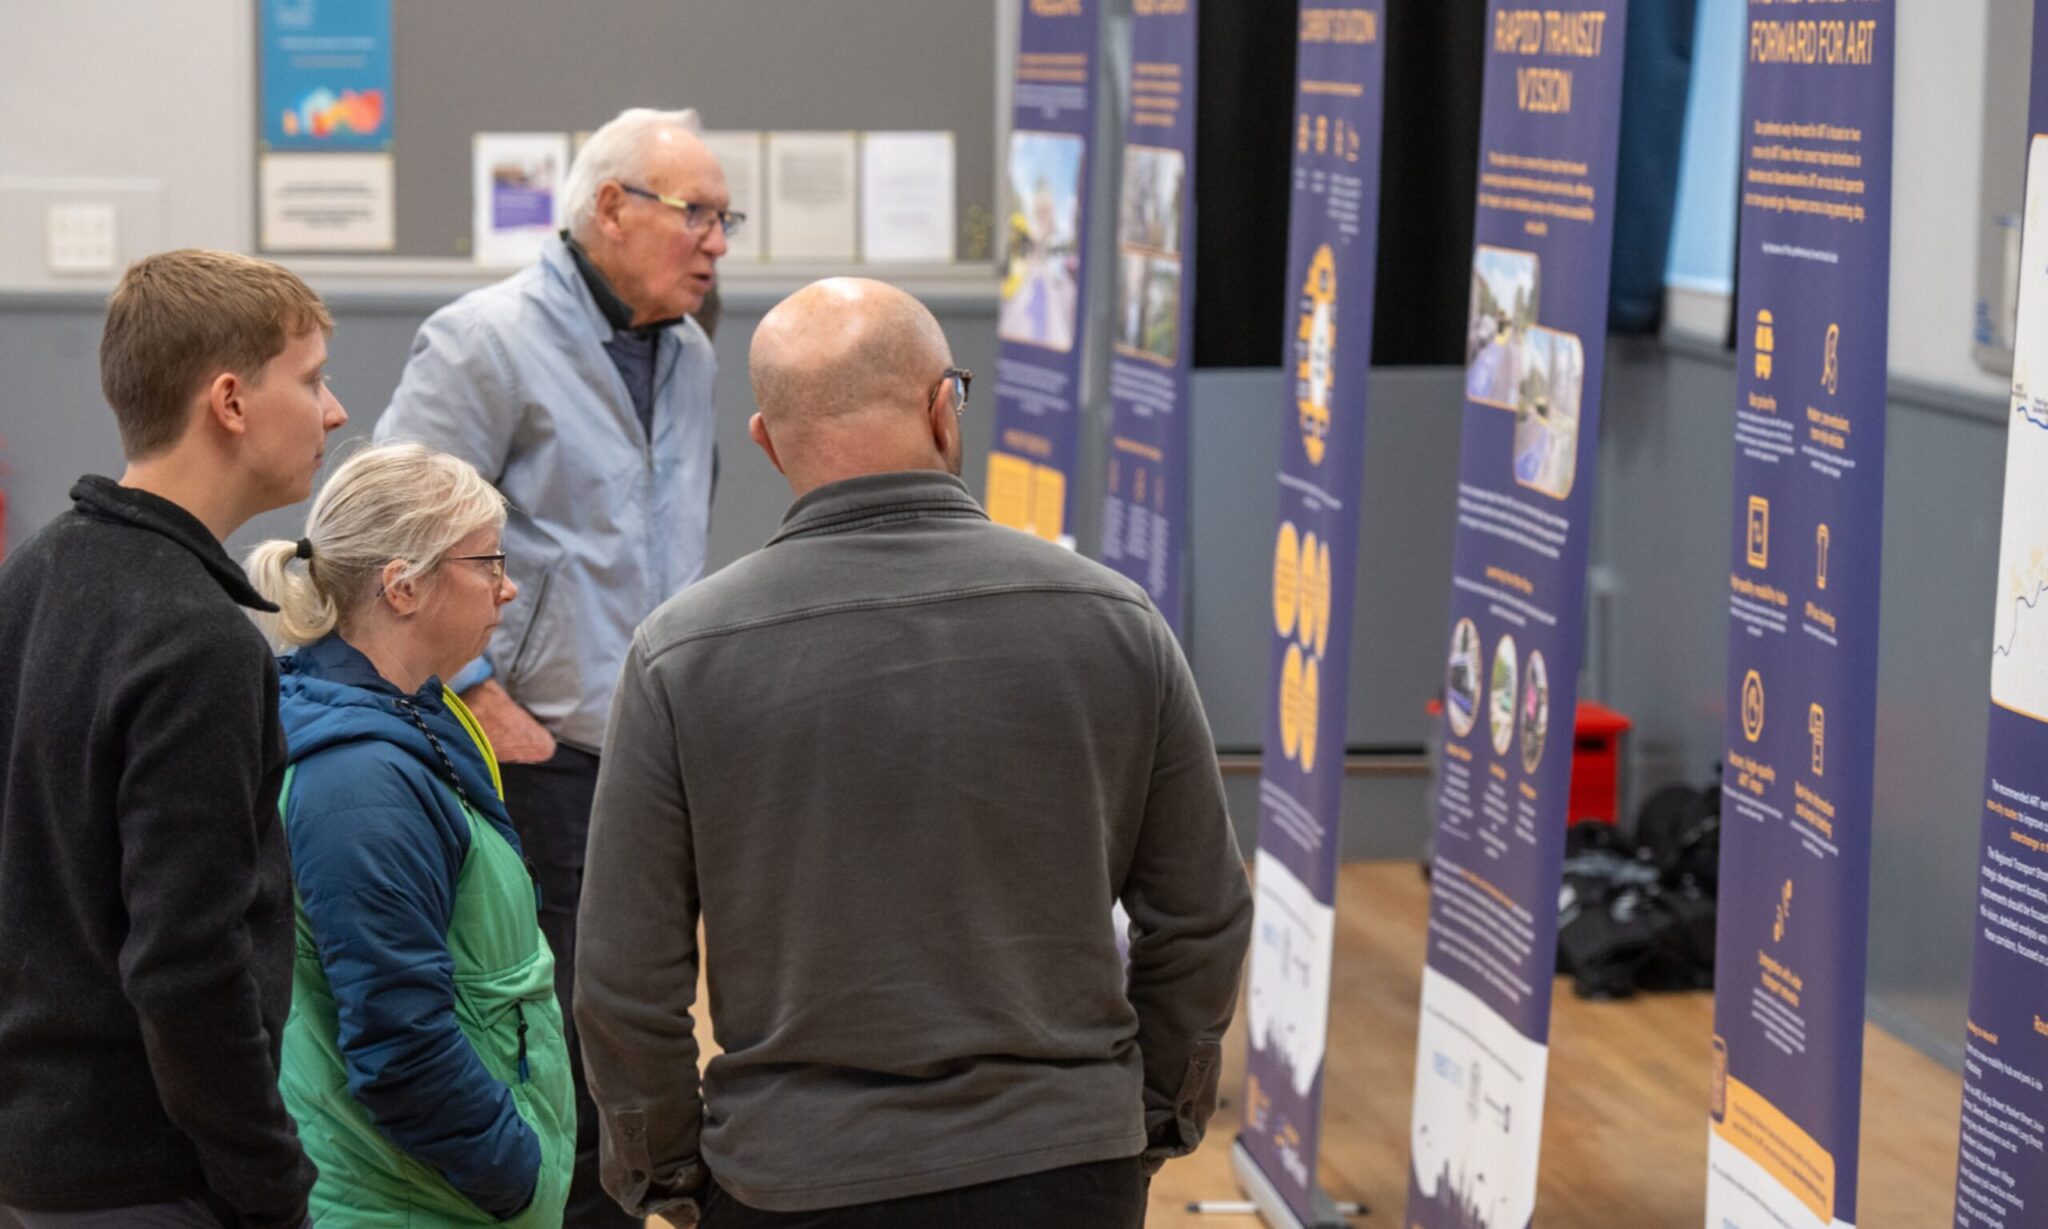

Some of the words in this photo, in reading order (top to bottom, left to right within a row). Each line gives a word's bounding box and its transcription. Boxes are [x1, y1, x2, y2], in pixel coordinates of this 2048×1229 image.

[1494, 9, 1542, 55] RAPID
[1544, 10, 1606, 57] TRANSIT
[1750, 20, 1817, 64] FORWARD
[1818, 20, 1845, 64] FOR
[1846, 20, 1876, 64] ART
[1516, 66, 1573, 114] VISION
